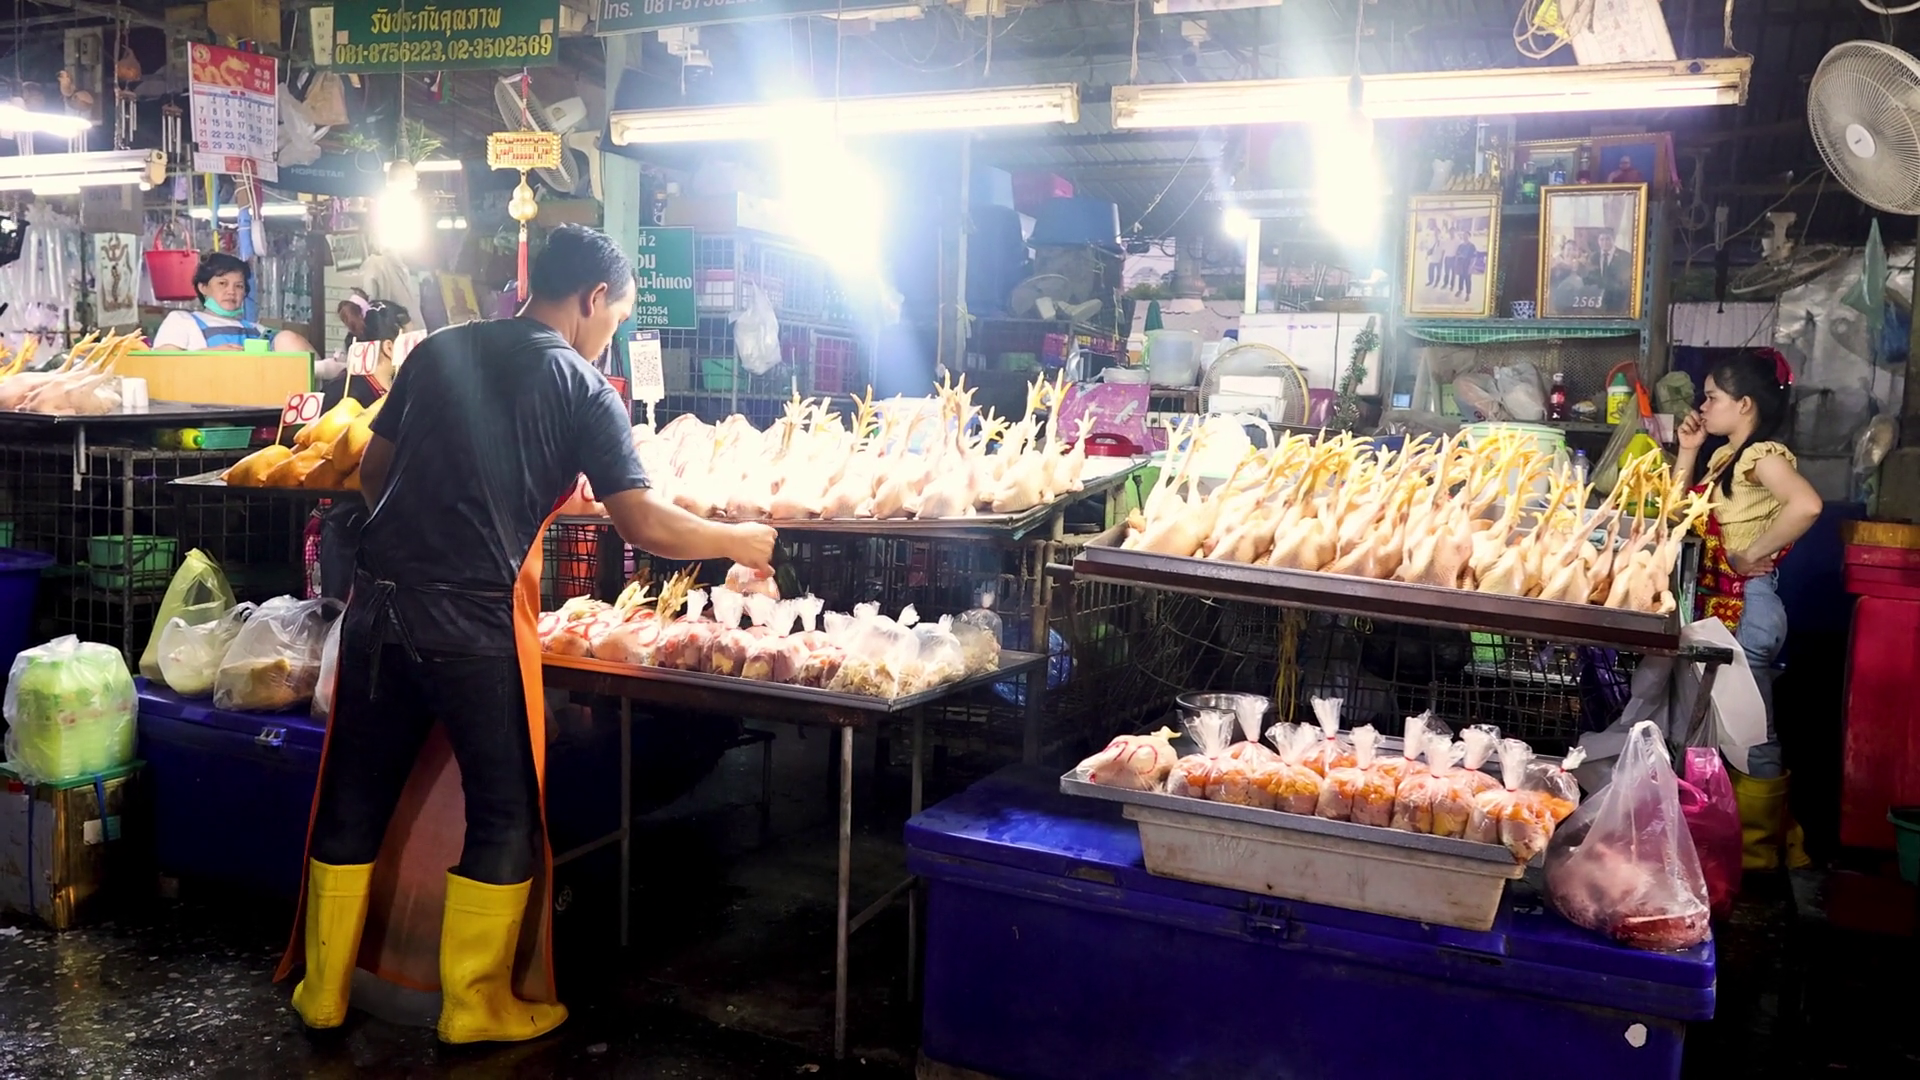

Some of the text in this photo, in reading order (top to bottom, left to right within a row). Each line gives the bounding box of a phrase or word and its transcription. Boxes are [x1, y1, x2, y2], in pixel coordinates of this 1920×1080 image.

[371, 5, 501, 37] รับประกันคุณภาพ
[212, 119, 220, 127] 15
[237, 110, 245, 119] 10
[256, 115, 262, 123] 12
[199, 129, 207, 137] 21
[211, 130, 221, 138] 22
[224, 131, 235, 139] 23
[237, 132, 246, 140] 24
[248, 134, 256, 142] 25
[266, 139, 273, 147] 27
[199, 140, 247, 151] 28 29 30 31
[648, 235, 656, 247] 2
[1572, 296, 1603, 308] 2563
[353, 340, 376, 375] 90
[283, 393, 320, 425] 80
